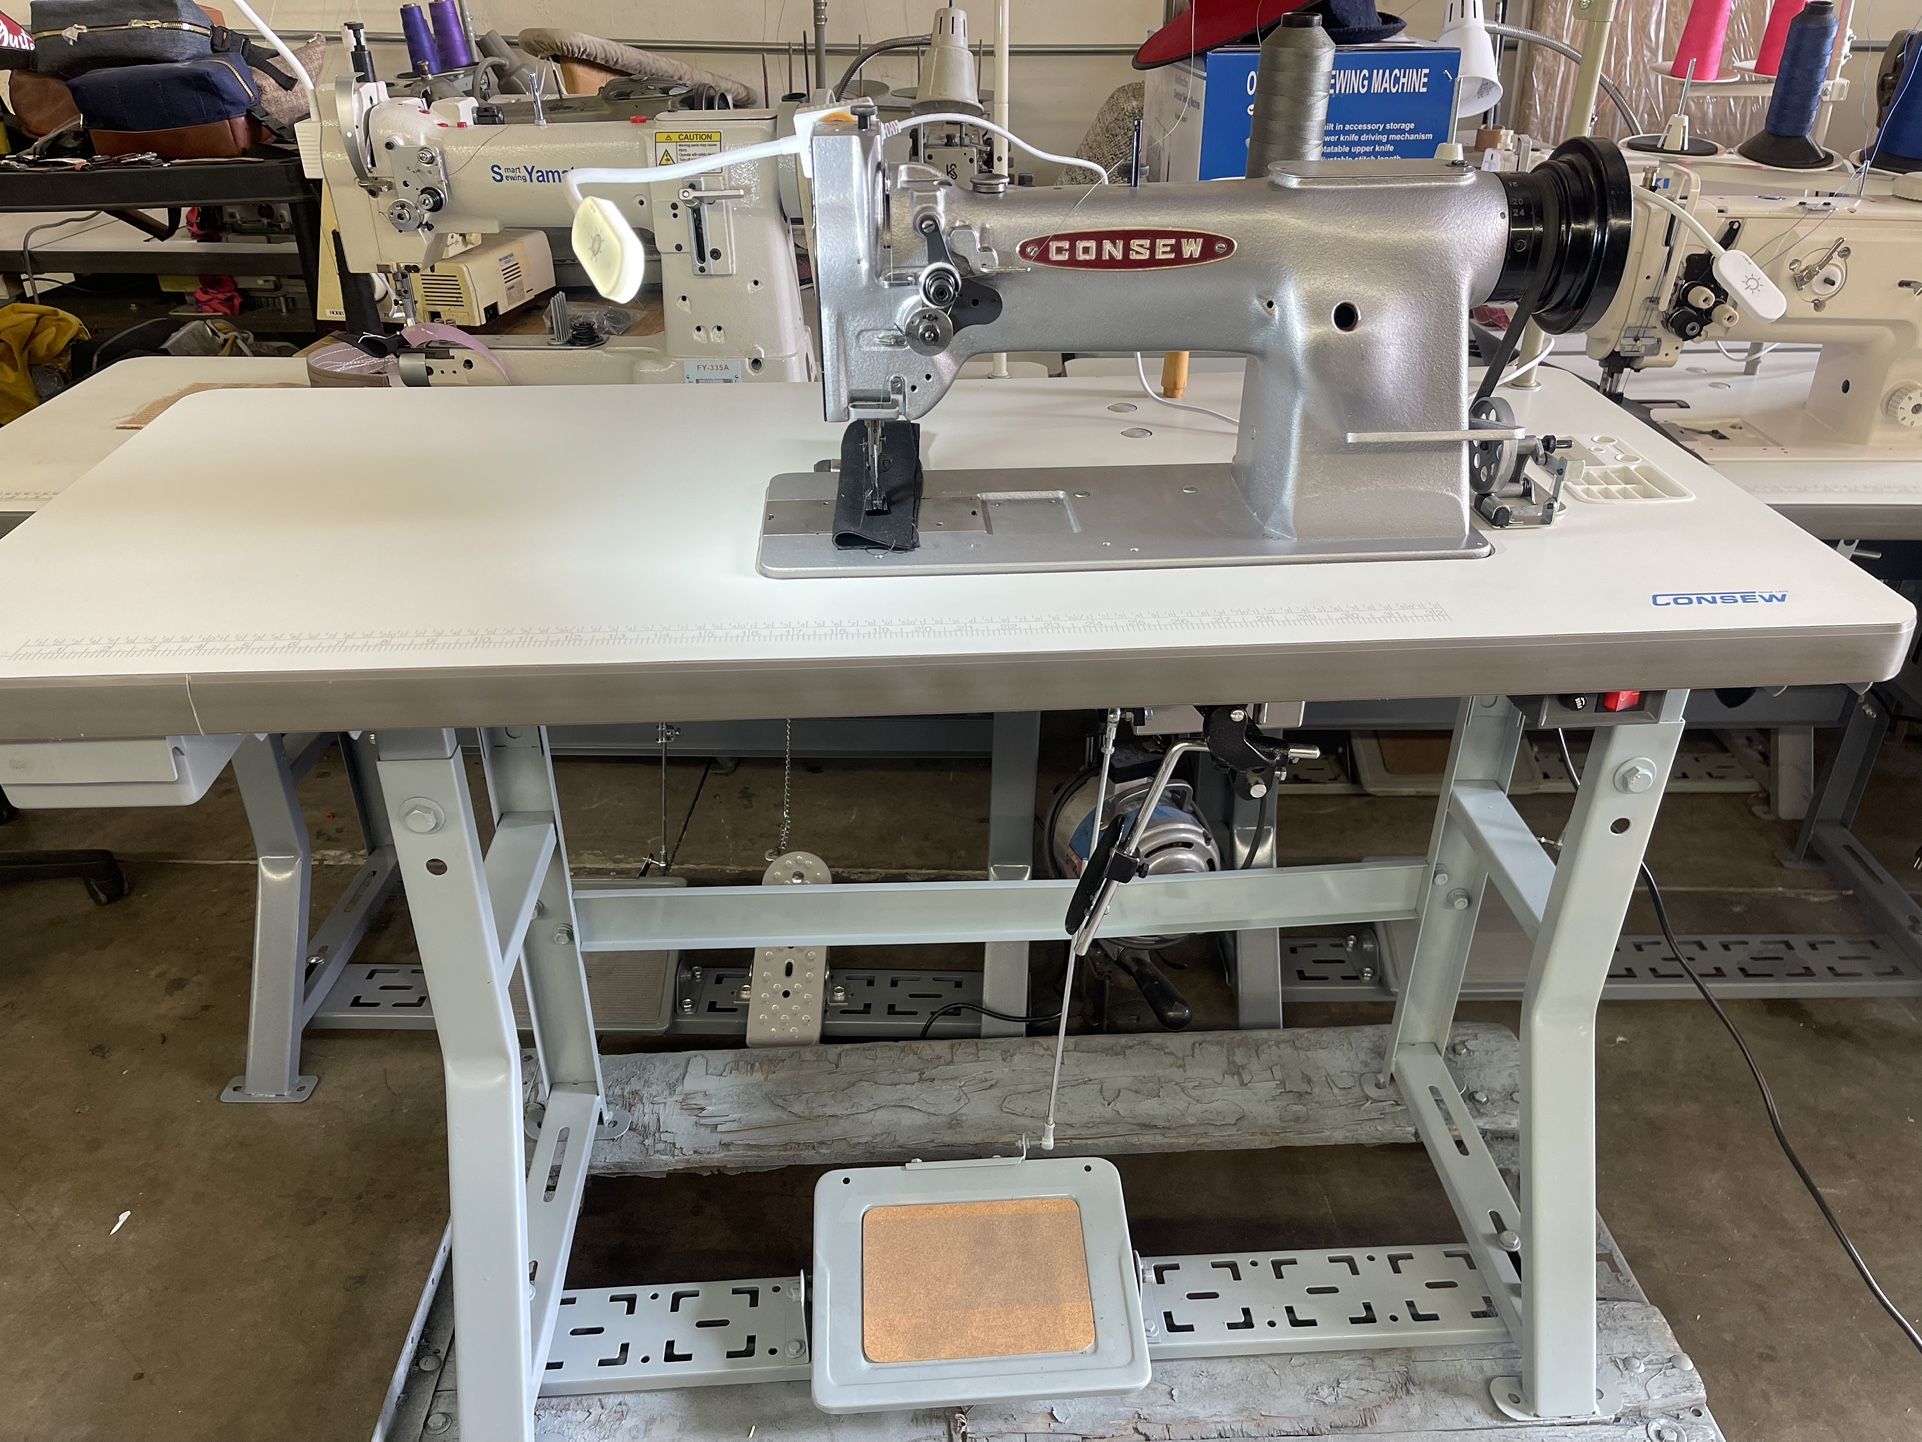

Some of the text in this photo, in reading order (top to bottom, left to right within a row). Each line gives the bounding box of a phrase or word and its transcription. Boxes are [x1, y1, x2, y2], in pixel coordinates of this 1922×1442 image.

[1330, 68, 1429, 94] EWING MACHINE
[1335, 122, 1343, 131] in
[1344, 123, 1384, 132] accessory
[1385, 122, 1415, 131] storage
[678, 133, 713, 141] CAUTION
[1340, 133, 1359, 142] knife
[1360, 133, 1388, 143] driving
[1389, 132, 1433, 141] mechanism
[1323, 144, 1394, 154] tatable upper knife
[523, 165, 574, 183] Yam
[1513, 208, 1525, 216] 24
[1049, 238, 1203, 260] CONSEW
[1652, 591, 1788, 607] CONSEW
